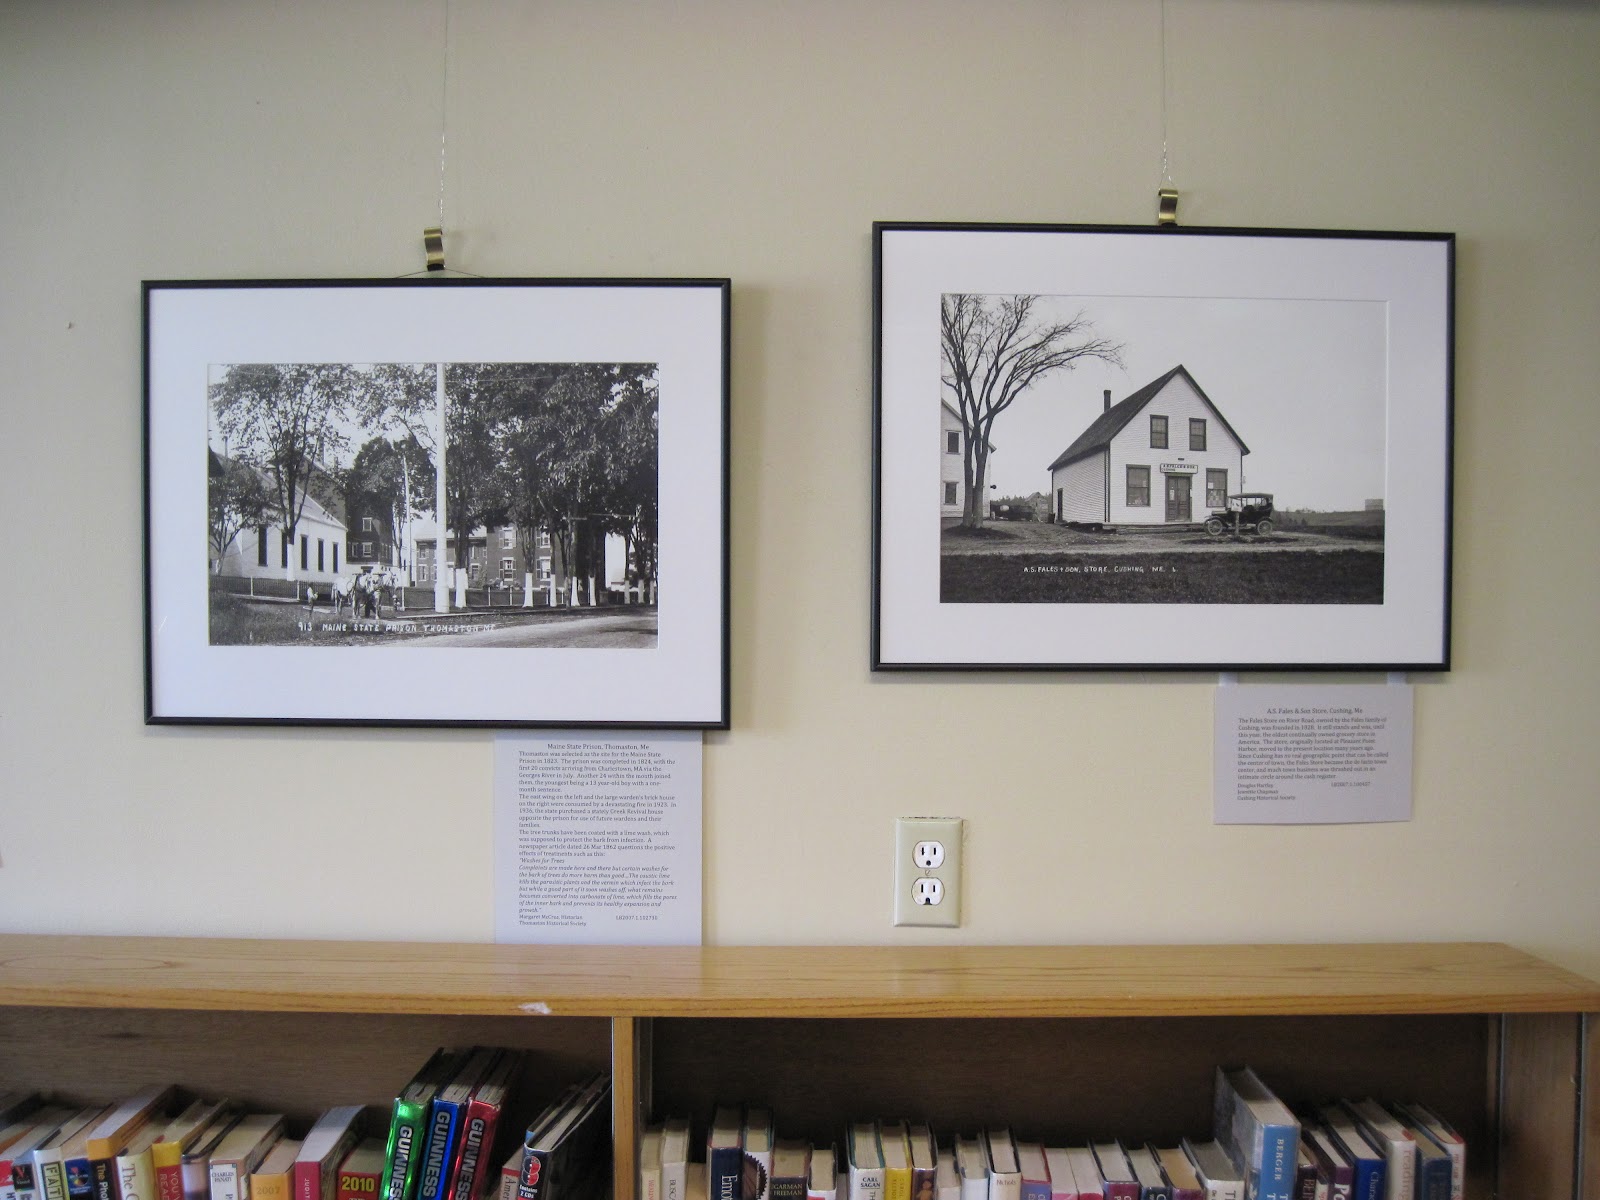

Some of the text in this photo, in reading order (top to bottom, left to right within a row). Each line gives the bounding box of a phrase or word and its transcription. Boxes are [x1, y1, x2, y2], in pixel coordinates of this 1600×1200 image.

[298, 622, 312, 632] 913
[322, 623, 347, 632] MAINE
[354, 623, 379, 632] STATE
[386, 623, 417, 632] PRISON
[423, 624, 478, 632] THOMASTON
[389, 1126, 412, 1200] GUINNES
[423, 1112, 450, 1198] GUINNESS
[1274, 1139, 1284, 1180] BERGER
[97, 1164, 105, 1180] The
[122, 1164, 136, 1190] The
[342, 1176, 374, 1192] 2010
[520, 1184, 538, 1193] Contains
